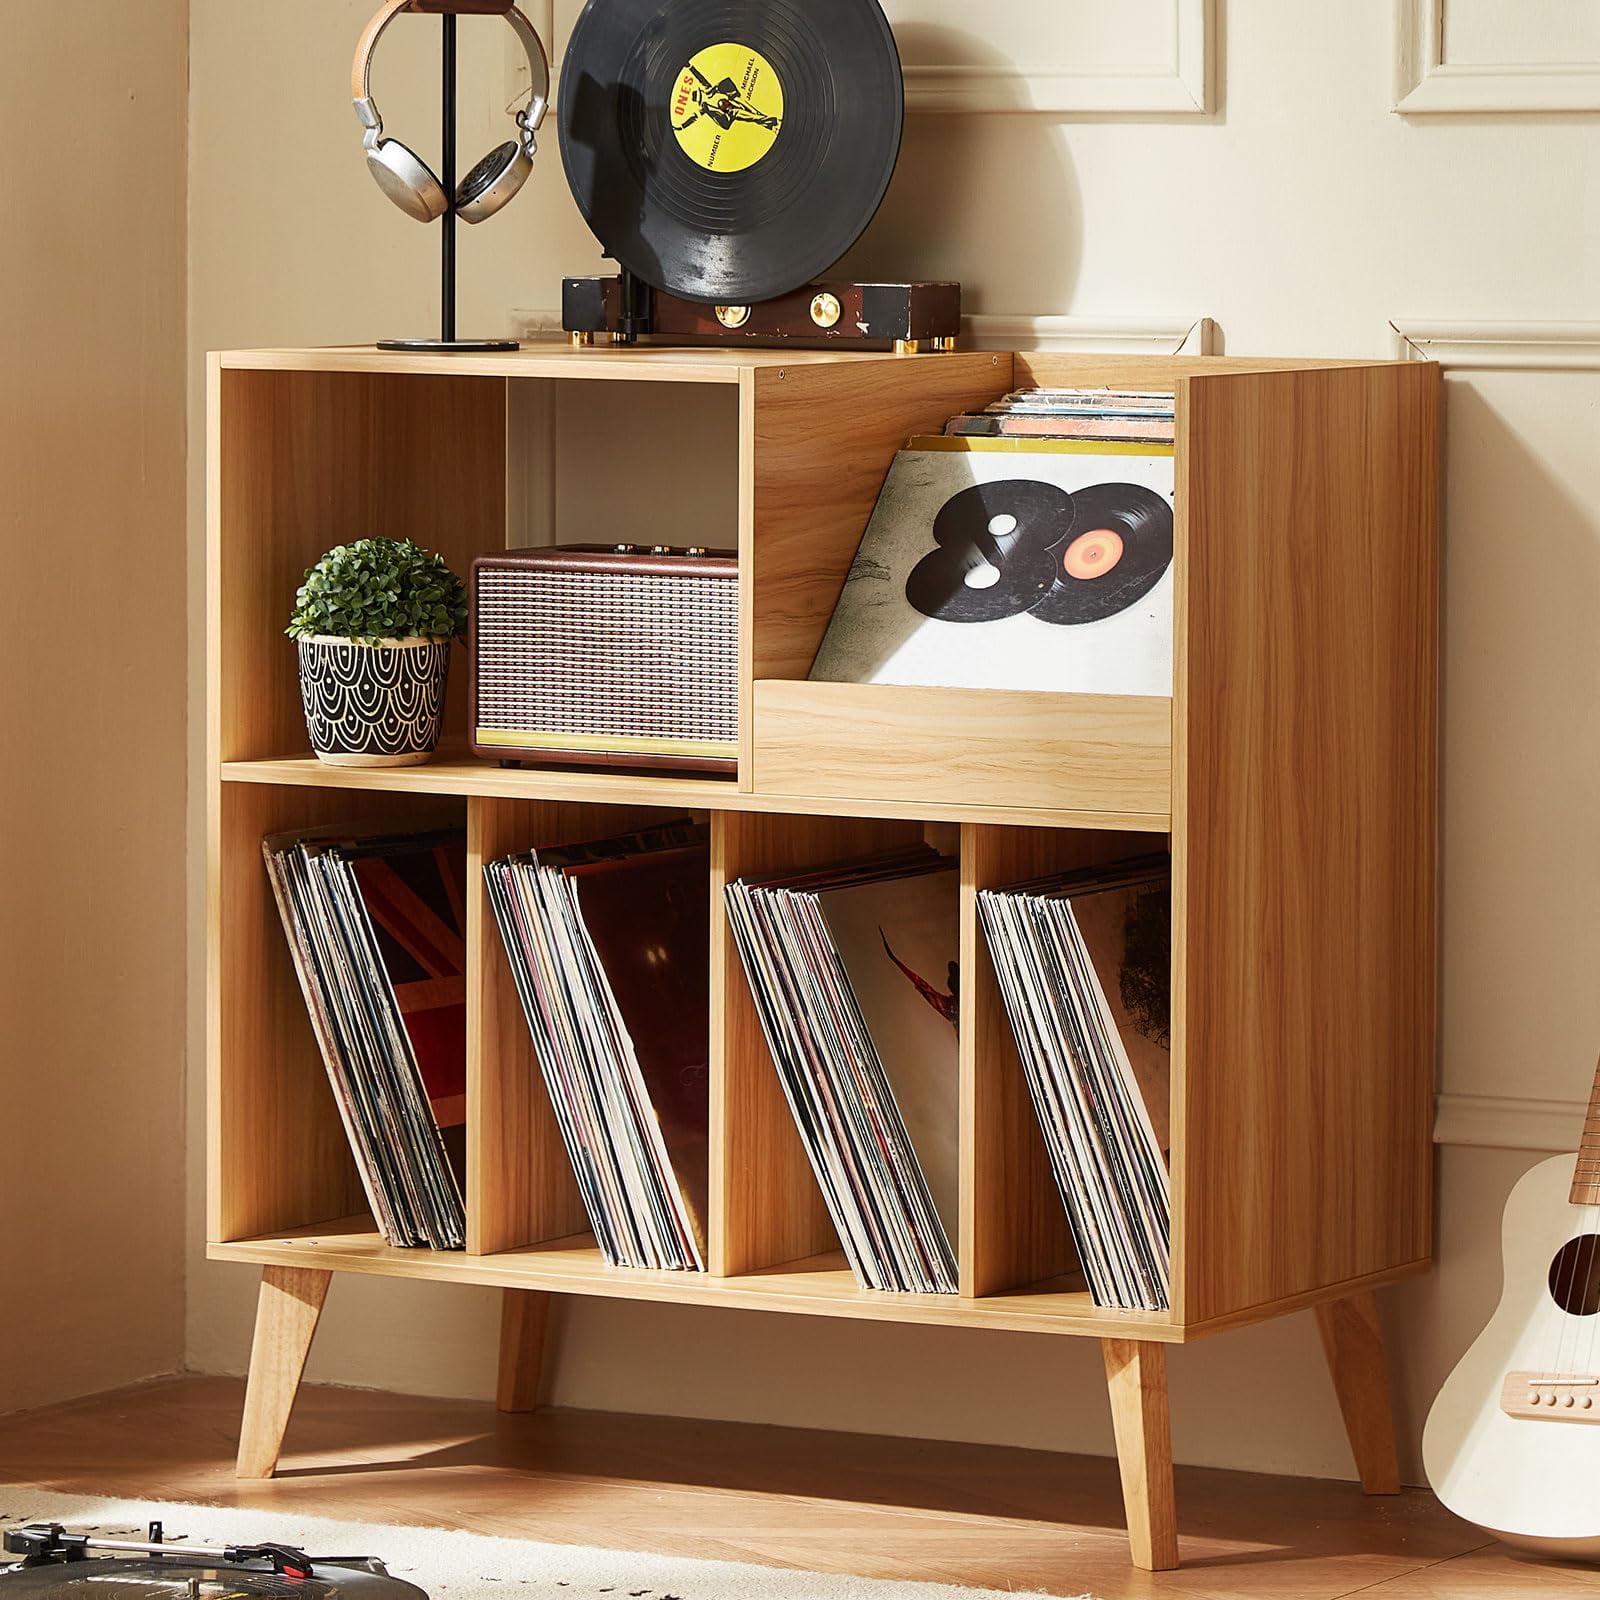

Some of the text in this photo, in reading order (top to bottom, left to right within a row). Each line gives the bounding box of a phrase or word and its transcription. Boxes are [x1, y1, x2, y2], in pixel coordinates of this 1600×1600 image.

[741, 57, 755, 90] MICHAEL
[746, 68, 759, 101] JACKSON
[674, 75, 694, 116] ONES
[707, 134, 721, 167] NUMBER
